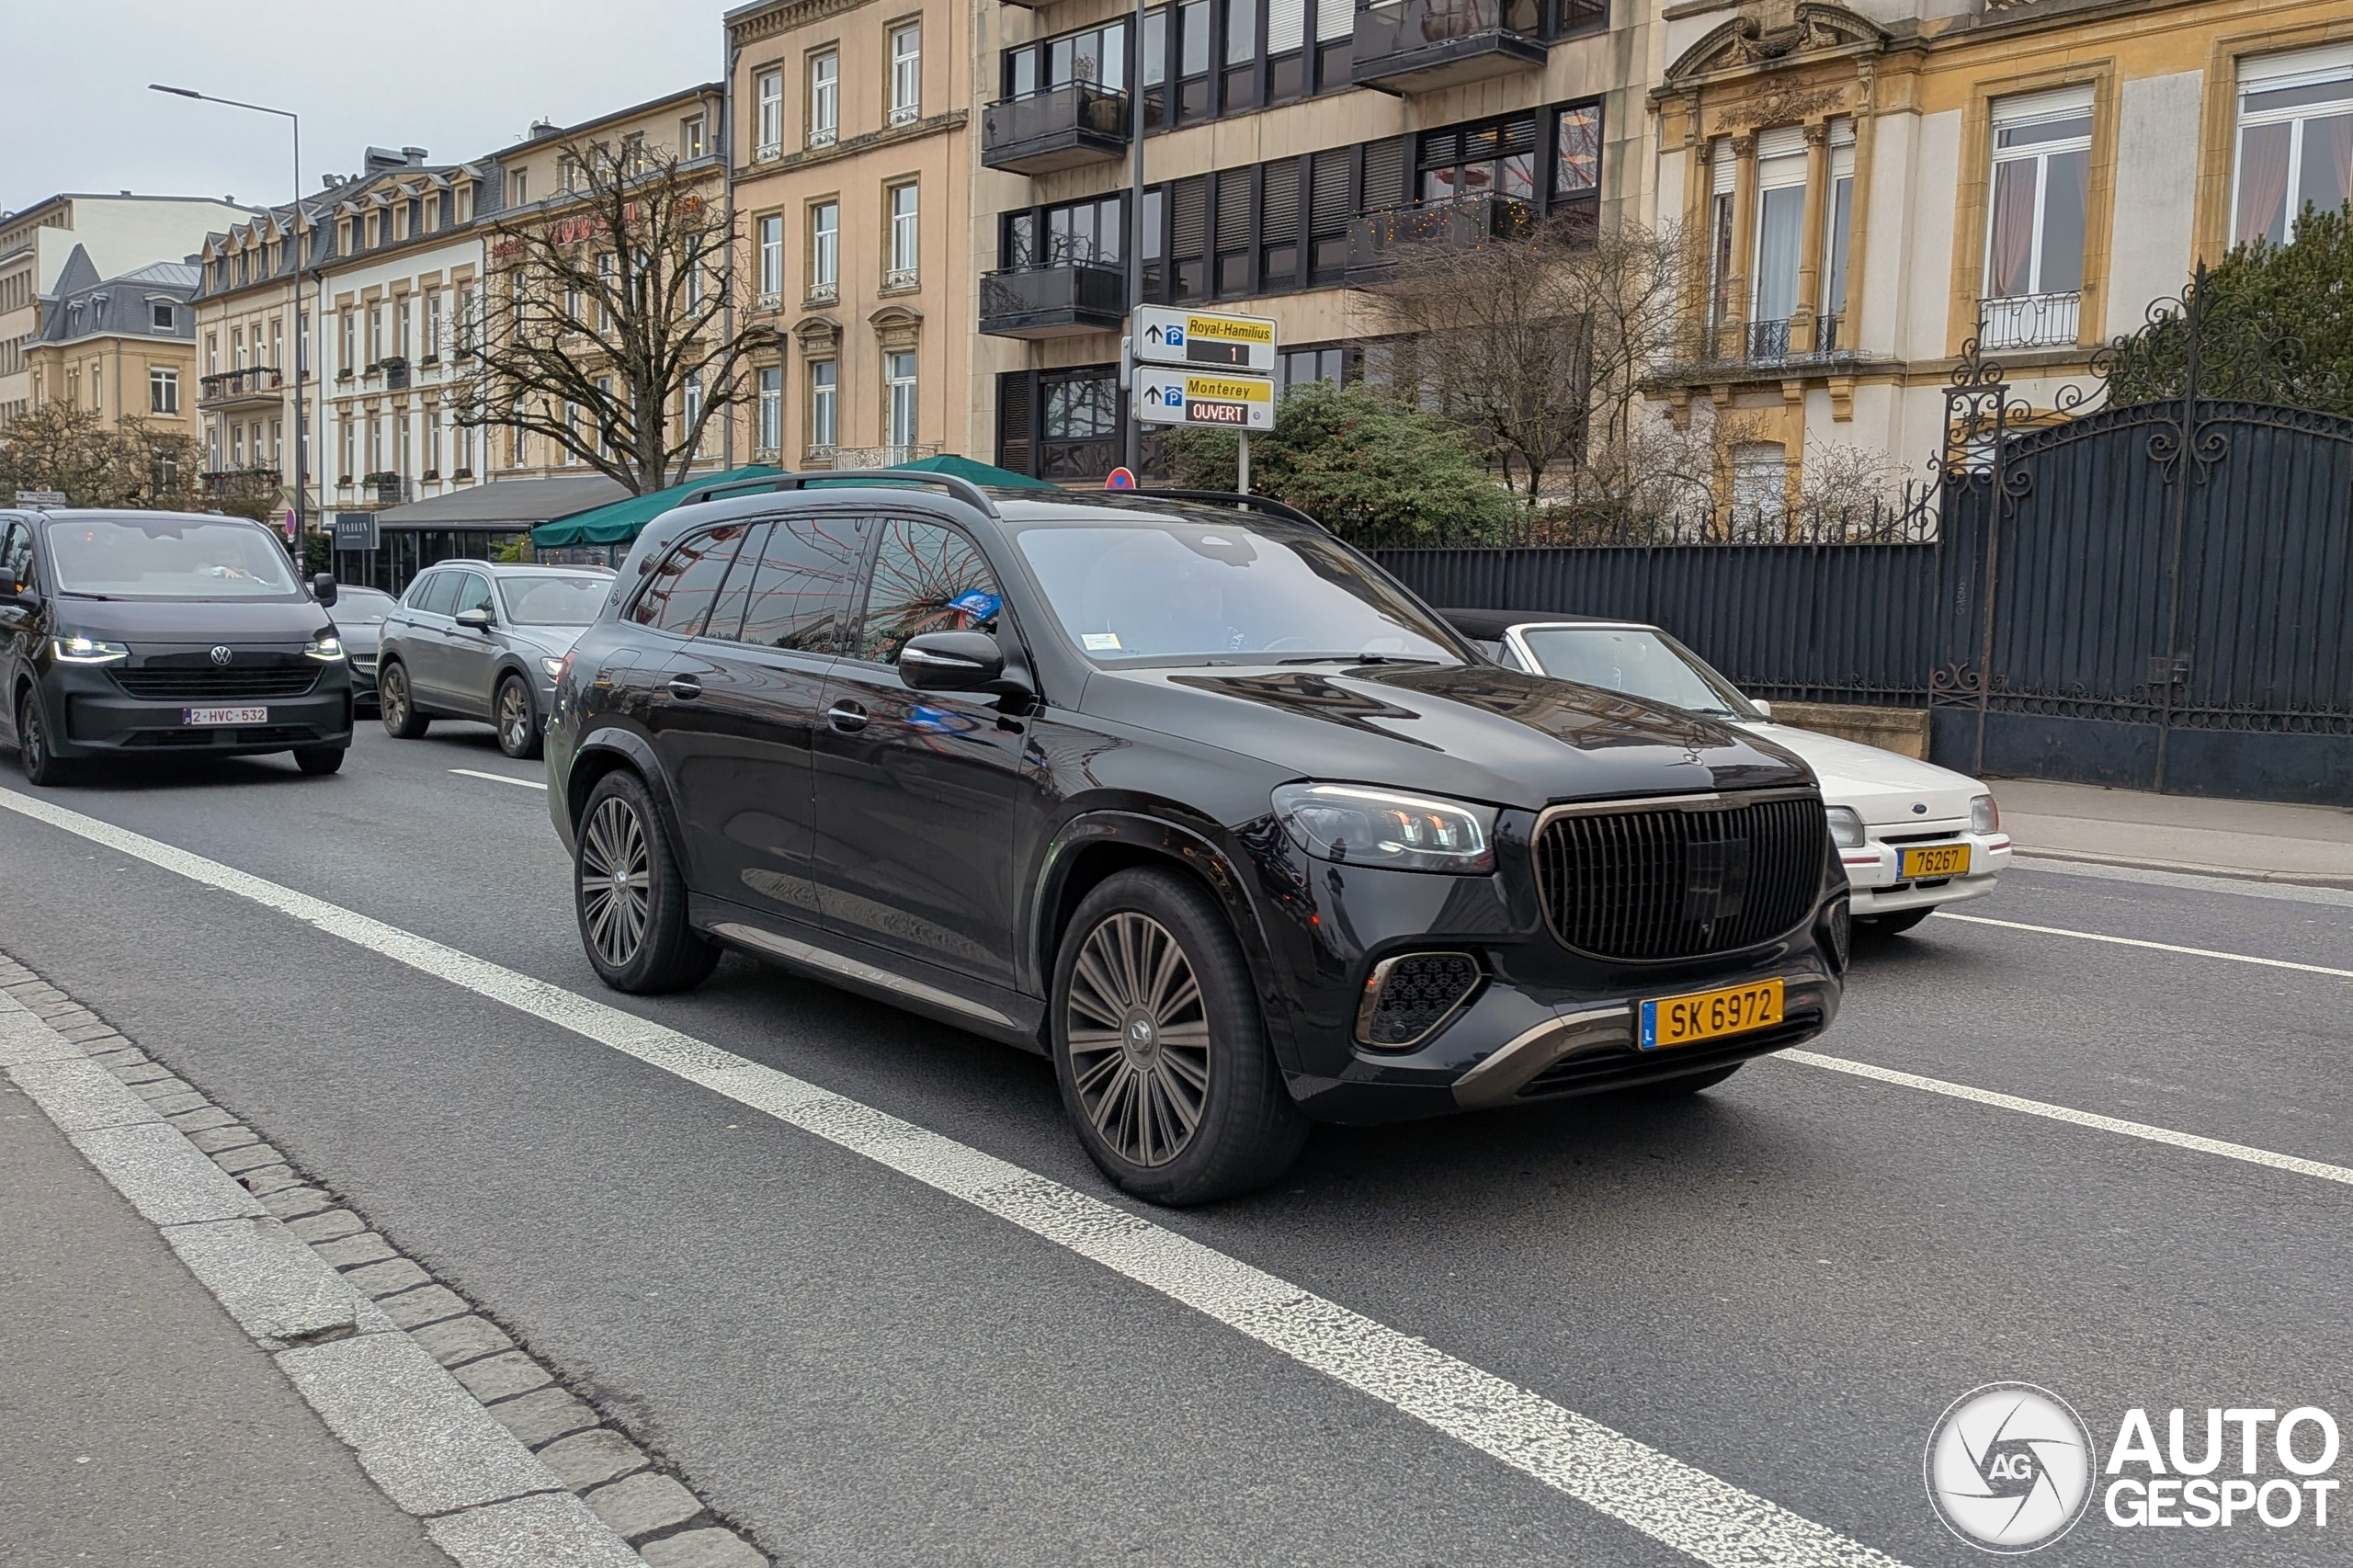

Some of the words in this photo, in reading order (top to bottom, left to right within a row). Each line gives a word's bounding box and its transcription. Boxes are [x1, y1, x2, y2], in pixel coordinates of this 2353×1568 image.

[1171, 332, 1179, 344] P
[1188, 319, 1270, 340] Royal-Hamilius
[1231, 347, 1236, 361] 1
[1170, 392, 1178, 404] P
[1188, 380, 1251, 399] Monterey
[1193, 403, 1244, 422] OUVERT
[192, 709, 266, 722] 2-HVC-532
[1917, 849, 1959, 872] 76267
[1644, 1028, 1653, 1041] L
[1671, 1000, 1705, 1038] SK
[1711, 988, 1772, 1031] 6972
